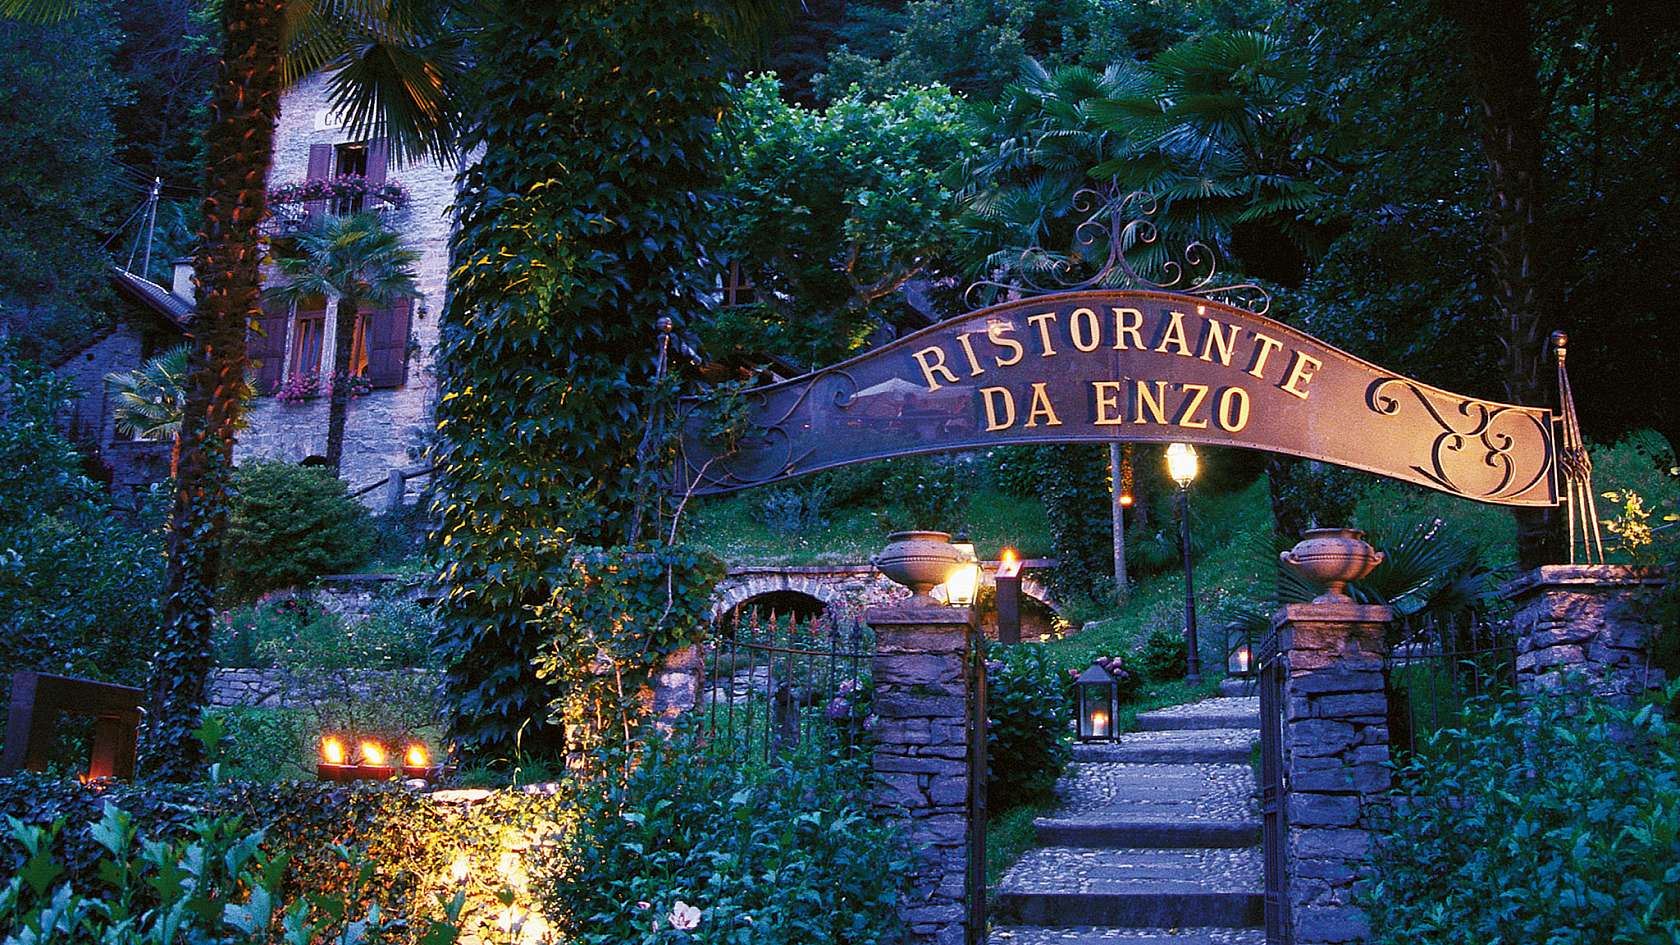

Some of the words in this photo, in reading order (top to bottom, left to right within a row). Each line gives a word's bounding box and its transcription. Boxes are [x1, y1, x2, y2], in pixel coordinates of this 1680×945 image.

[912, 307, 1322, 400] RISTORANTE
[980, 382, 1062, 432] DA
[1093, 380, 1251, 433] ENZO
